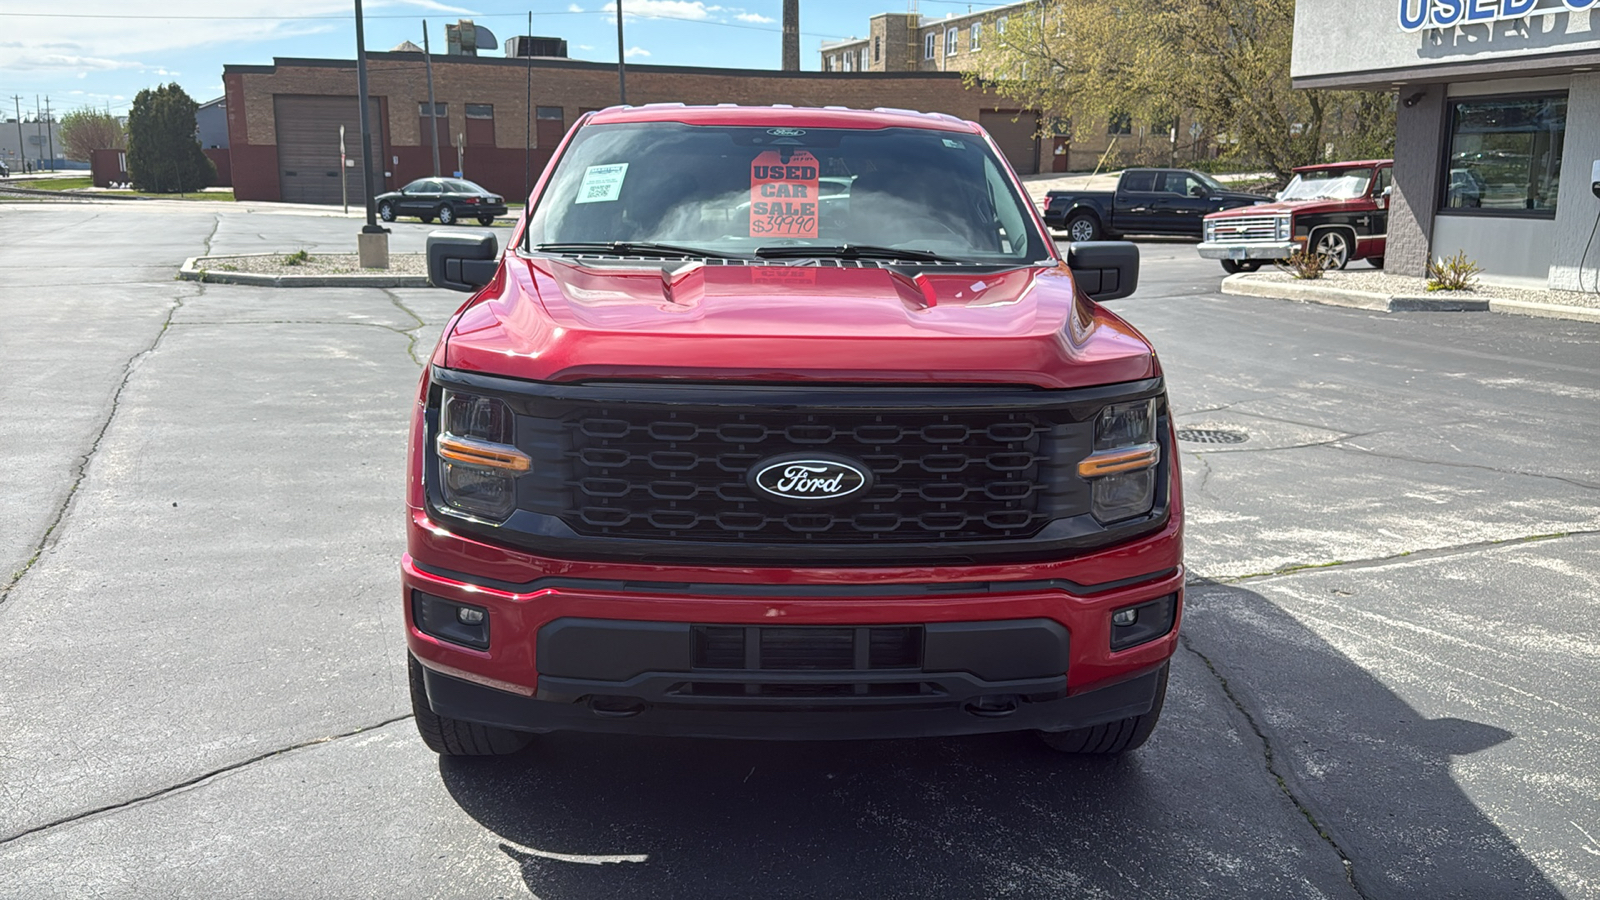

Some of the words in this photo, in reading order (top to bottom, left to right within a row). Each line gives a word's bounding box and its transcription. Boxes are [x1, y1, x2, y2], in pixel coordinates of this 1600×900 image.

[754, 166, 817, 180] USED
[761, 183, 808, 198] CAR
[753, 202, 815, 216] SALE
[752, 216, 815, 233] $39990
[777, 465, 844, 492] Ford
